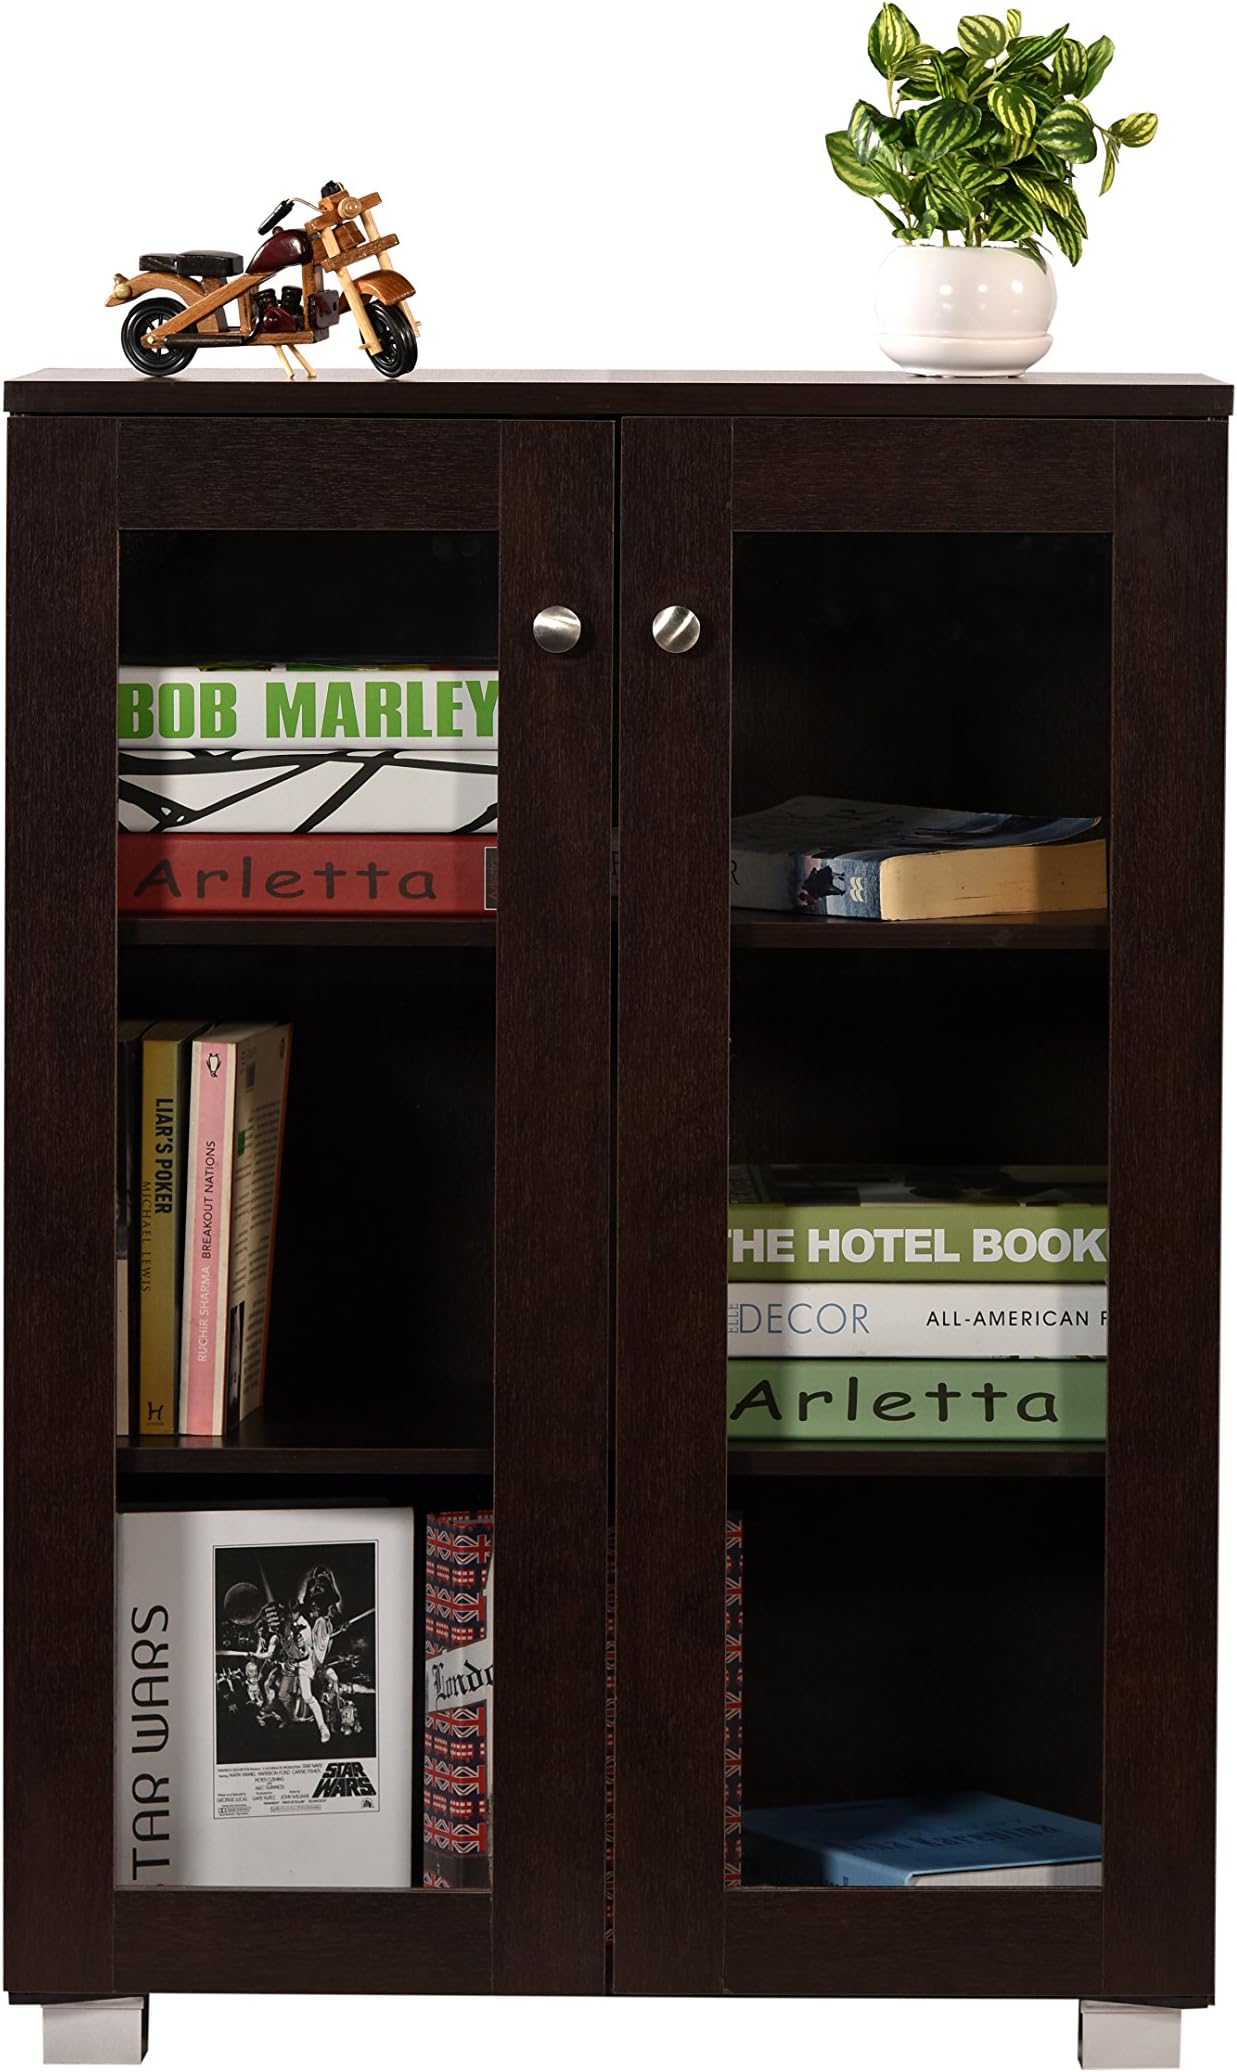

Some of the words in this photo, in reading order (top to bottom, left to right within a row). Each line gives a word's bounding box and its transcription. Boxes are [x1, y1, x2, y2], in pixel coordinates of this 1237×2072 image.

[119, 682, 237, 739] BOB
[265, 680, 499, 739] MARLEY
[133, 855, 437, 899] Arletta
[155, 1098, 174, 1154] LIAR'S
[154, 1158, 173, 1214] POKER
[204, 1140, 216, 1193] NATIONS
[142, 1181, 152, 1245] MICHAEL
[202, 1196, 214, 1259] BREAKOUT
[807, 1228, 960, 1263] HOTEL
[972, 1228, 1108, 1263] BOOK
[142, 1252, 152, 1293] LEWIS
[199, 1266, 210, 1316] SHARMA
[197, 1319, 209, 1362] RUCHIR
[740, 1302, 870, 1334] DECOR
[926, 1310, 1090, 1326] ALL-AMERICAN
[729, 1376, 1059, 1423] Arletta
[131, 1604, 170, 1754] WARS
[312, 1777, 377, 1799] WARS
[322, 1762, 367, 1779] STAR
[132, 1772, 170, 1886] TAR
